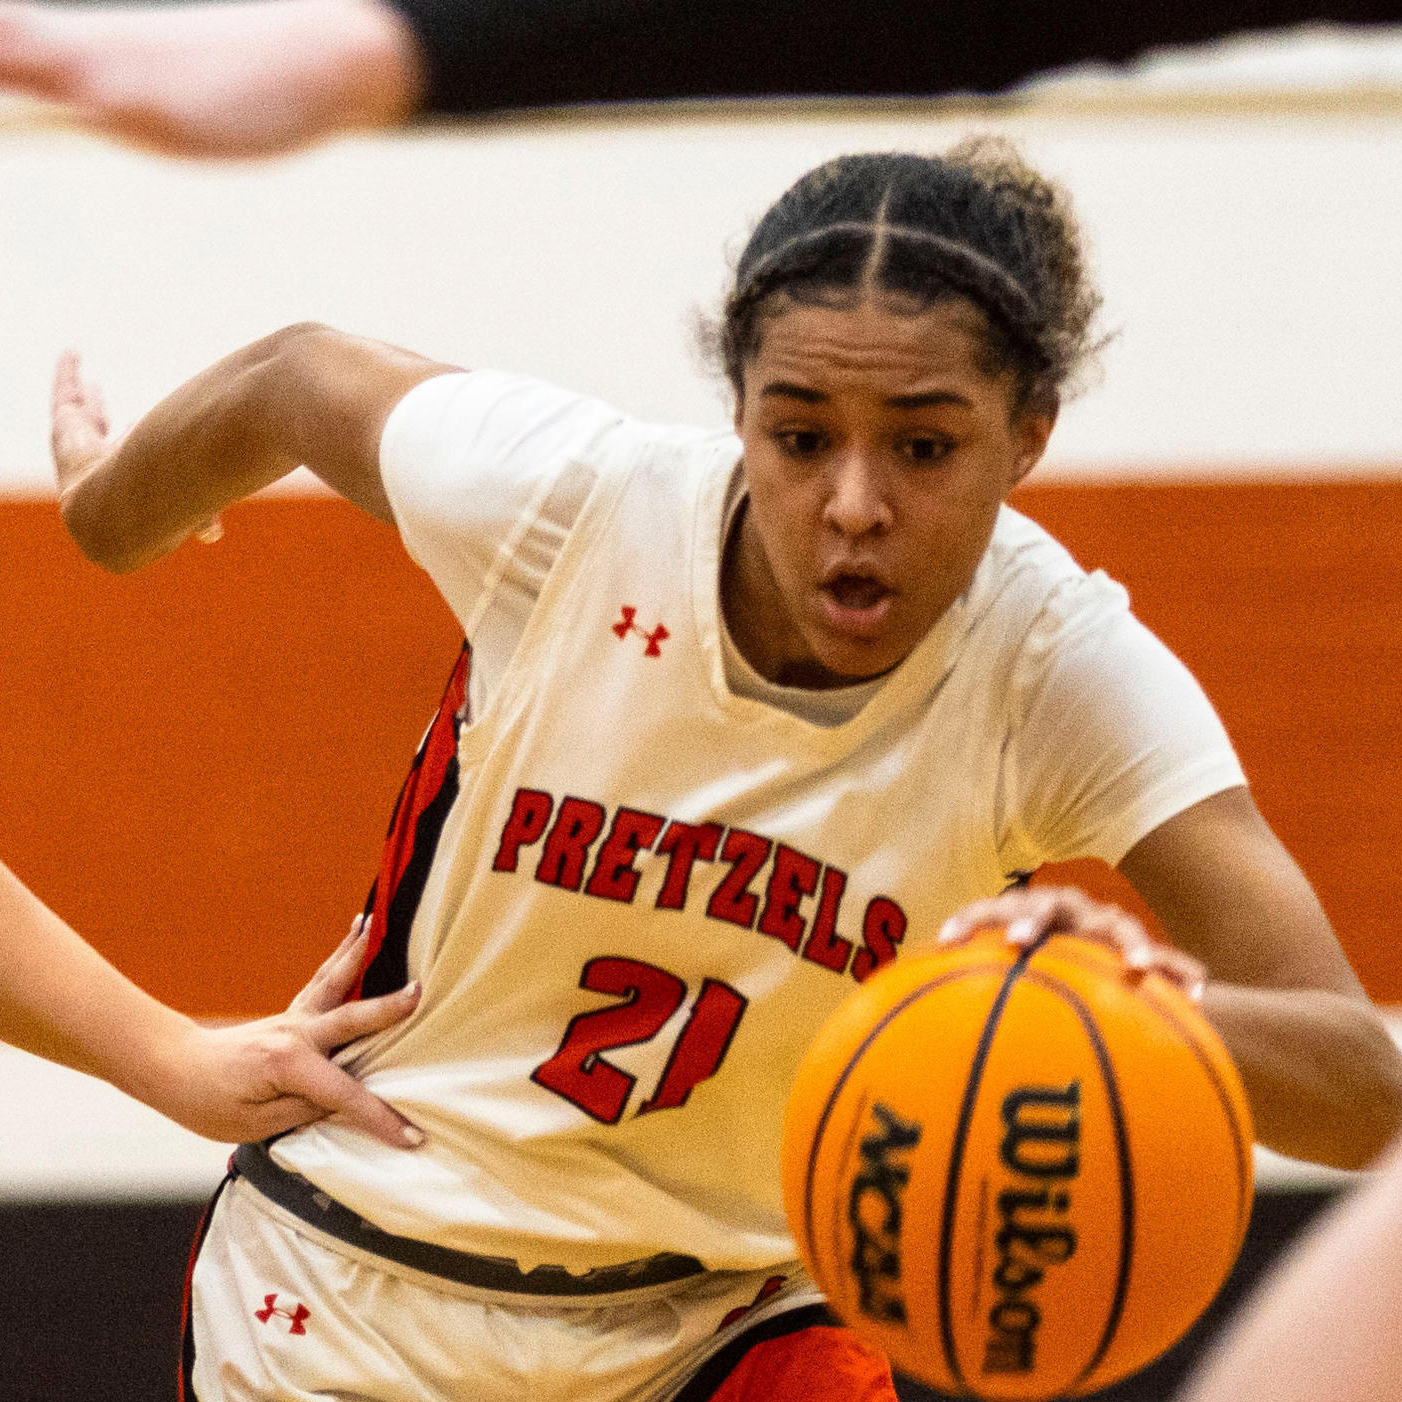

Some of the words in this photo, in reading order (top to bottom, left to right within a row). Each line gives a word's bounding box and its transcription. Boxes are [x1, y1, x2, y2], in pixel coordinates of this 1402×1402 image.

[491, 786, 908, 984] PRETZELS
[529, 954, 750, 1126] 21
[849, 1101, 923, 1330] NCAA
[983, 1078, 1082, 1376] Wilson
